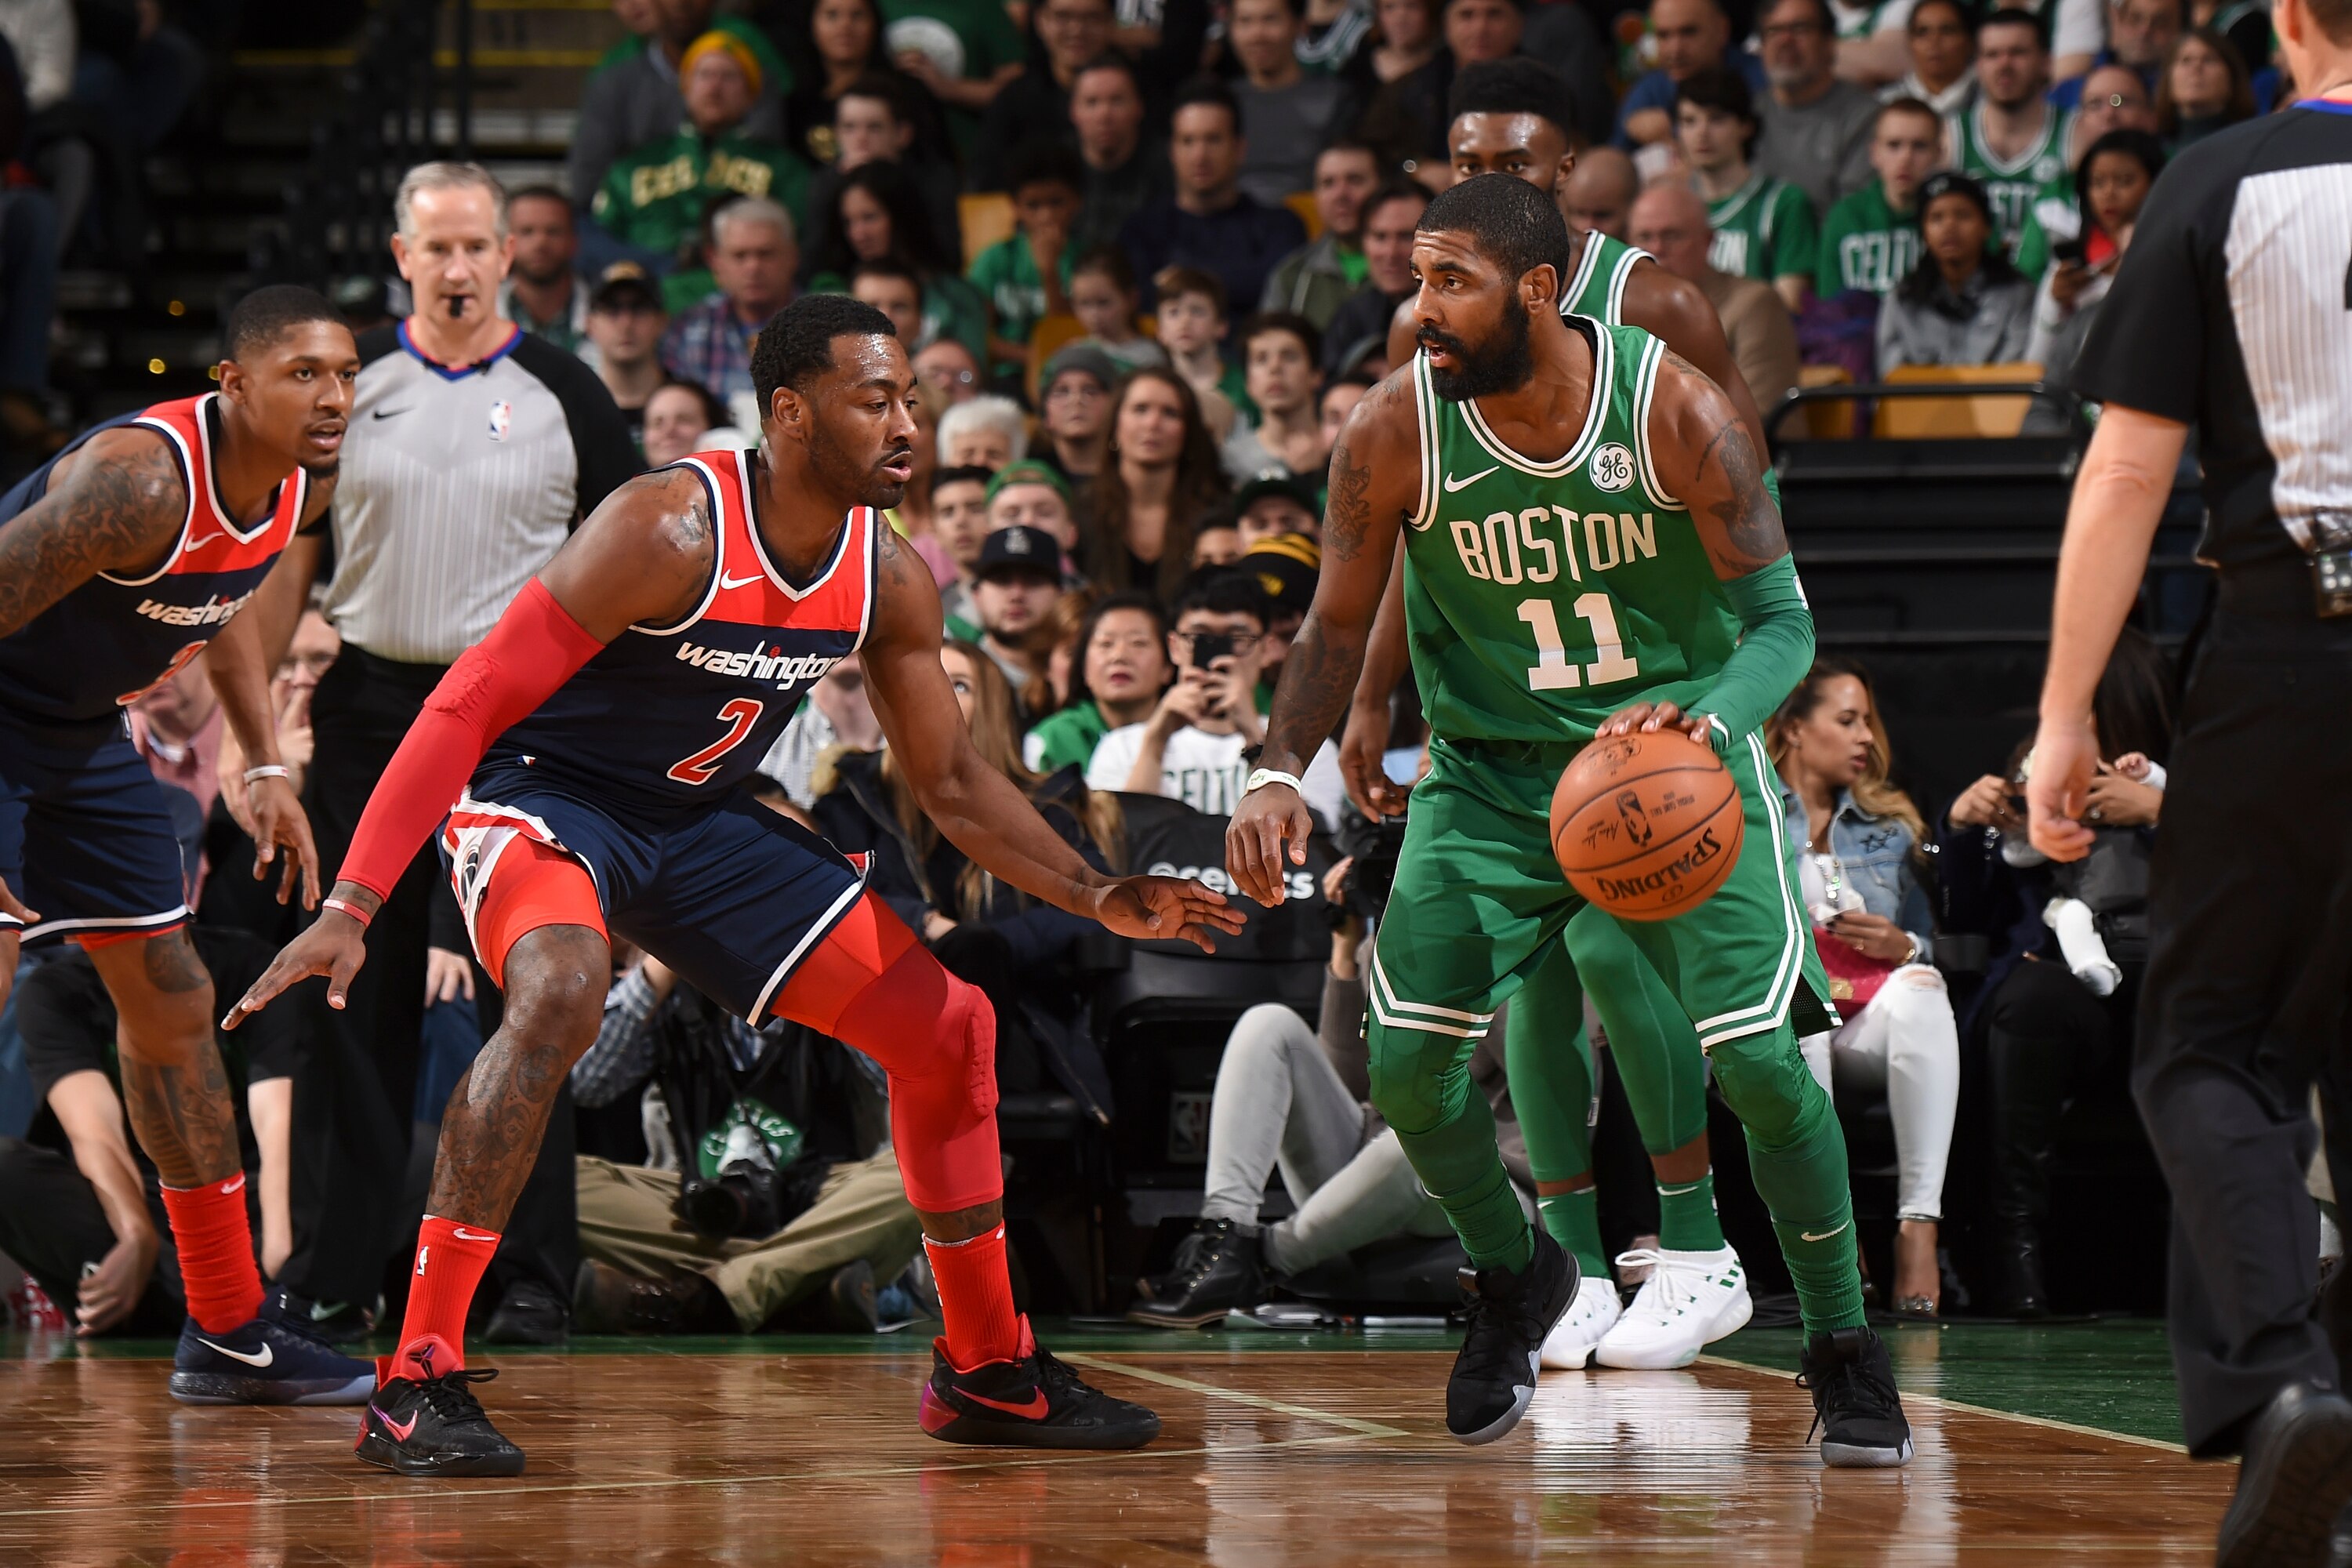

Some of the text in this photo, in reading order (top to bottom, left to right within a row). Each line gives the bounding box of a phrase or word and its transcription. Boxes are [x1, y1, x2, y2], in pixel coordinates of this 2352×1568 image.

[1449, 504, 1658, 586] BOSTON
[675, 640, 844, 691] washington
[1516, 593, 1639, 691] 11
[666, 697, 764, 786] 2
[1593, 826, 1722, 901] SPALDING
